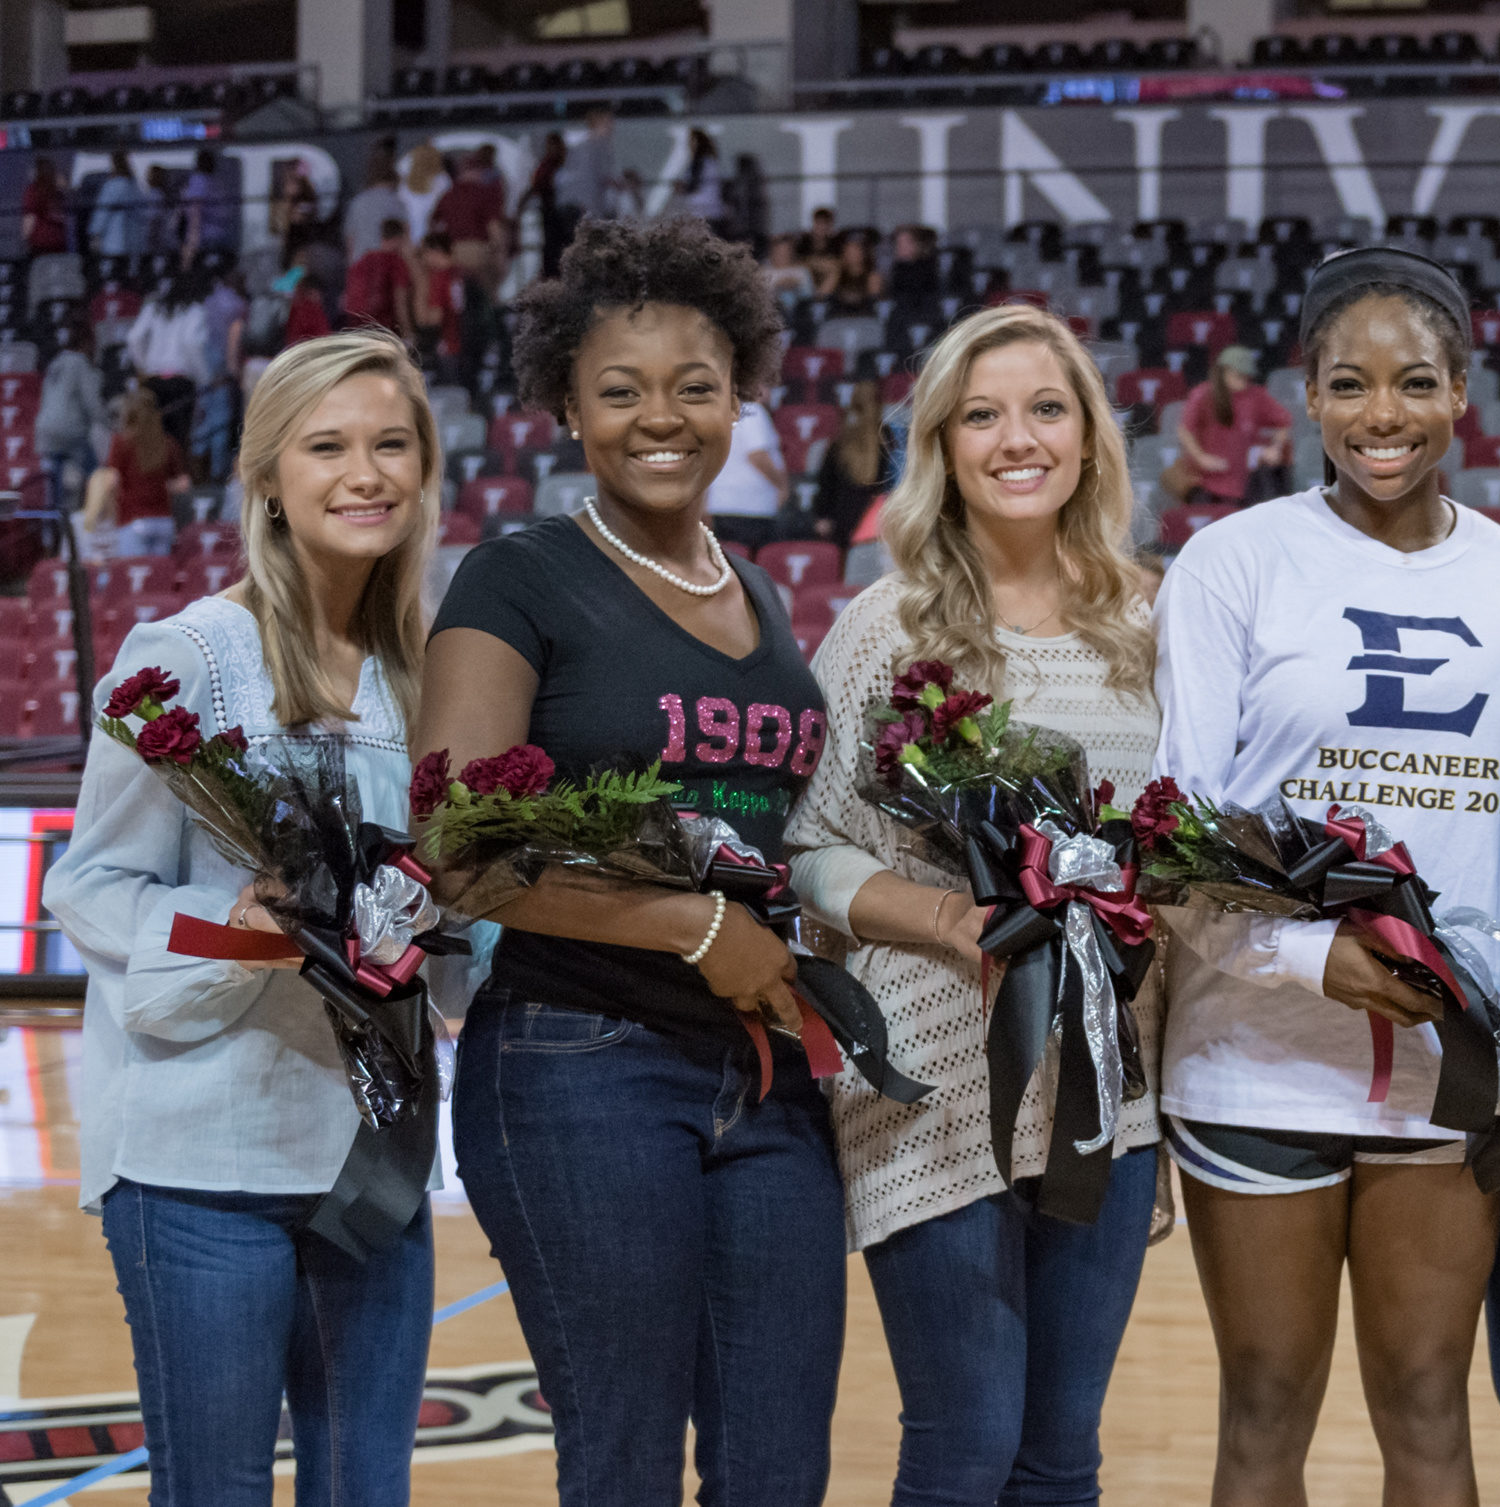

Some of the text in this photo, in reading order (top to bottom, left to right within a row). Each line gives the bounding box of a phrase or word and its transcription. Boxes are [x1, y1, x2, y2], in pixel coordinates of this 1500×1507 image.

[1342, 607, 1489, 738] E
[659, 693, 828, 777] 1908
[1317, 746, 1500, 781] BUCCANEER
[1279, 778, 1456, 811] CHALLENGE
